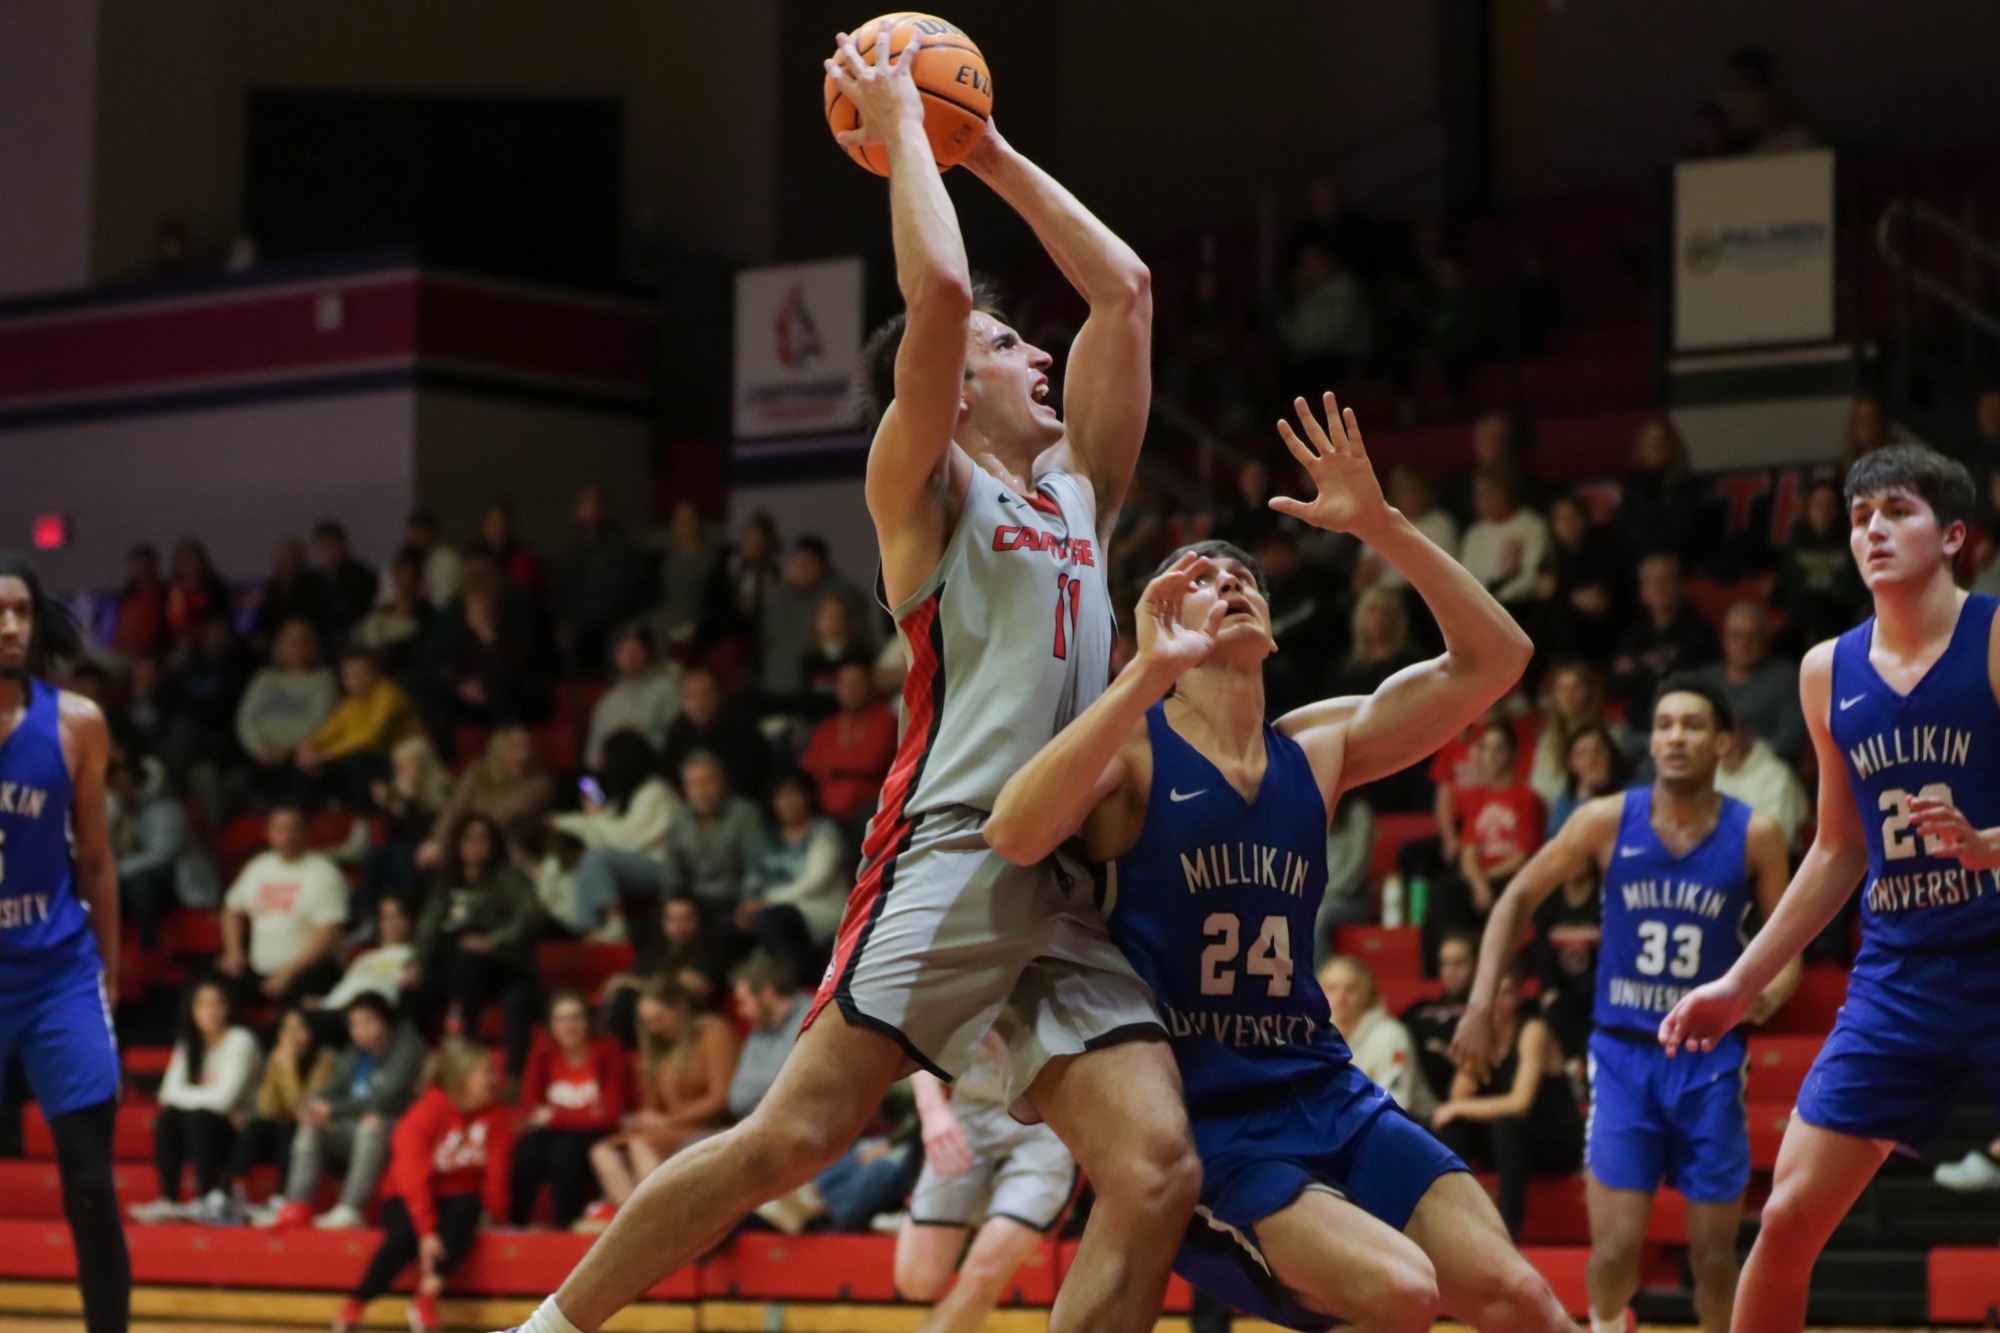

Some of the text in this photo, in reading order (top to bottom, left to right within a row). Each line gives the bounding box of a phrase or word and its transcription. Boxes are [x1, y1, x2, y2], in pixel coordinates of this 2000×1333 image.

[1850, 725, 1971, 781] MILLIKIN
[1180, 842, 1309, 898] MILLIKIN
[1622, 879, 1727, 919] MILLIKIN
[1200, 912, 1294, 997] 24
[1635, 920, 1703, 979] 33
